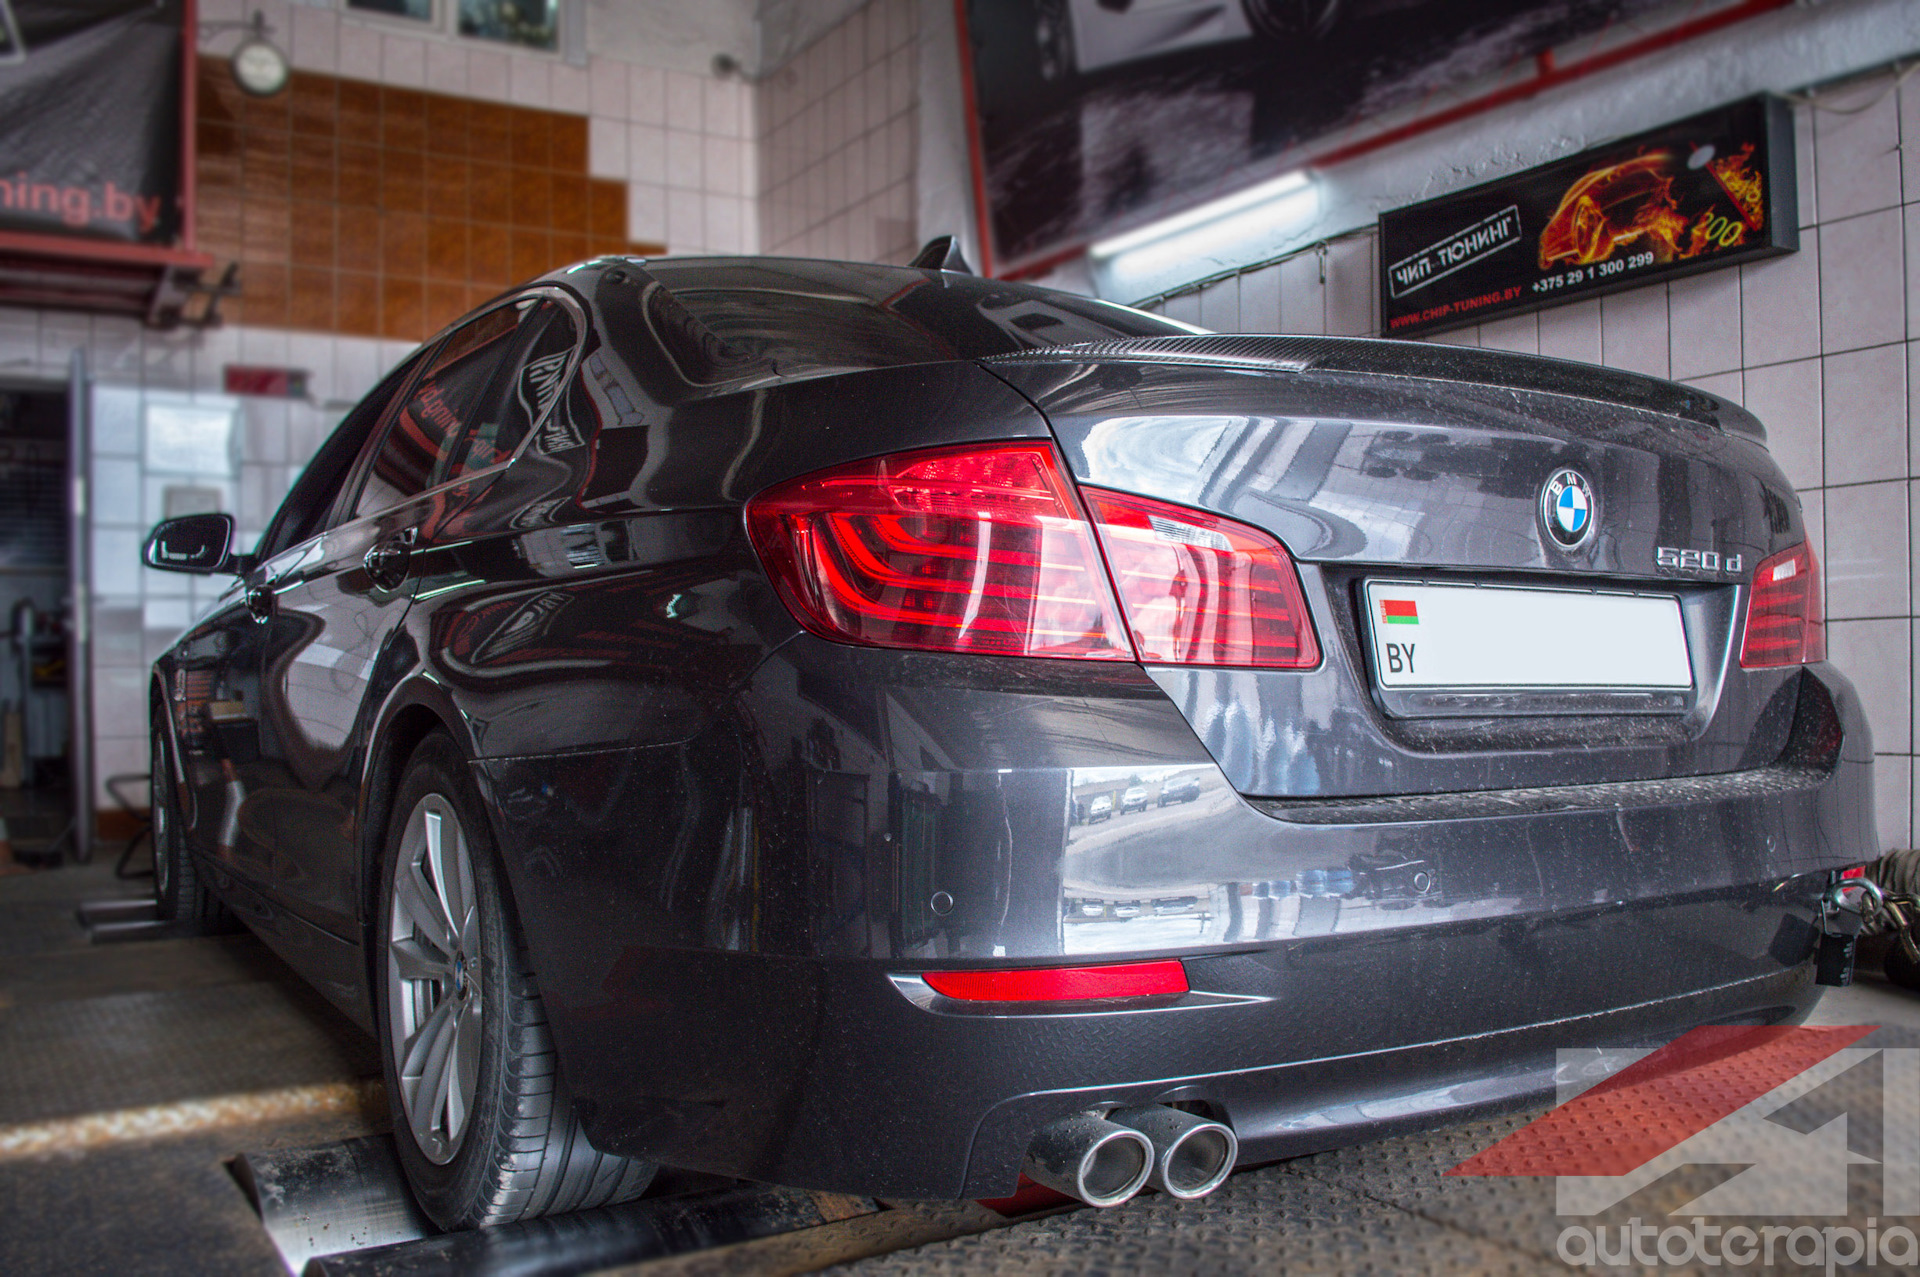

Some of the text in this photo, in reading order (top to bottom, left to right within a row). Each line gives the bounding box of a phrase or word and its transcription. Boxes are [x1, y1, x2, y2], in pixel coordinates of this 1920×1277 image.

[1532, 251, 1654, 292] +375 29 1 300 299
[1390, 286, 1522, 328] WWW.CHIP-TUNING.BY
[1550, 472, 1591, 498] BMW
[1386, 643, 1415, 673] BY
